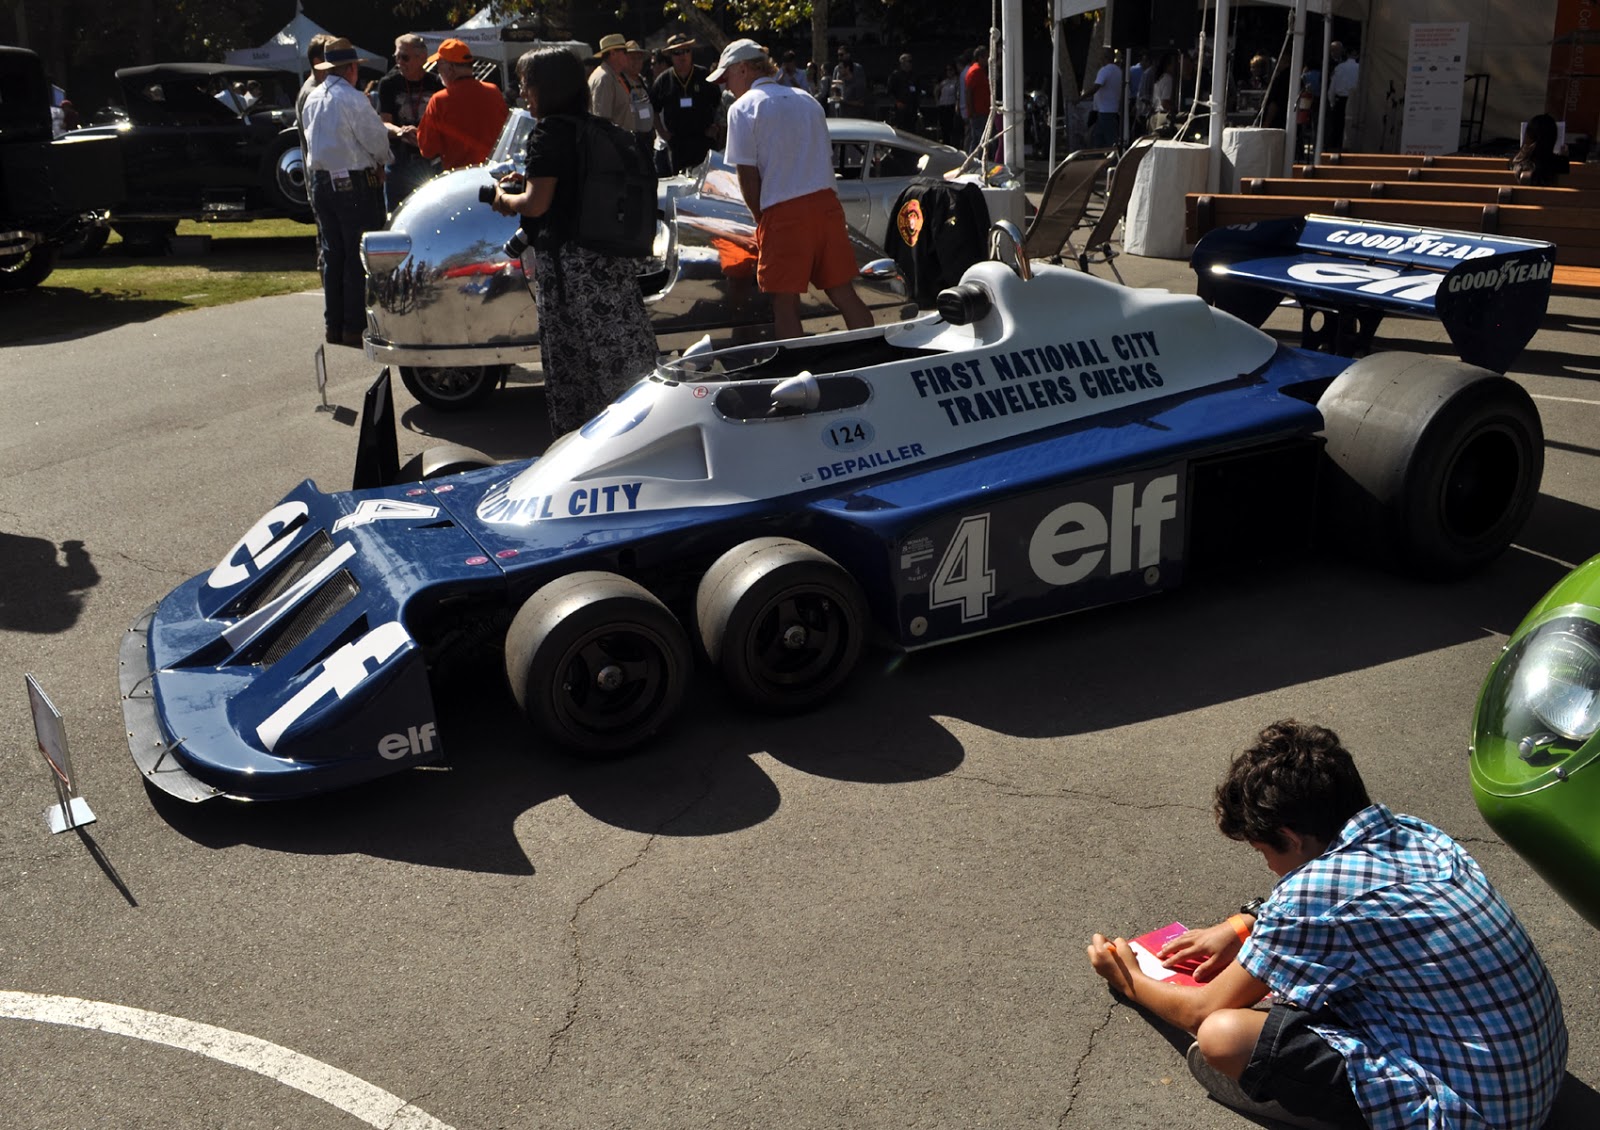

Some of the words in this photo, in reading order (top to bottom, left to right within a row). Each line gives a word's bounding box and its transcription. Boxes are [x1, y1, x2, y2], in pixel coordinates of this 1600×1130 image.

[910, 359, 985, 398] FIRST
[990, 338, 1109, 381] NATIONAL
[1111, 331, 1161, 361] CITY
[938, 376, 1077, 427] TRAVELERS
[1079, 361, 1164, 400] CHECKS
[829, 422, 866, 446] 124
[817, 442, 926, 481] DEPAILLER
[568, 481, 643, 516] CITY
[1028, 473, 1179, 586] elf
[929, 512, 997, 624] 4
[377, 722, 437, 761] elf
